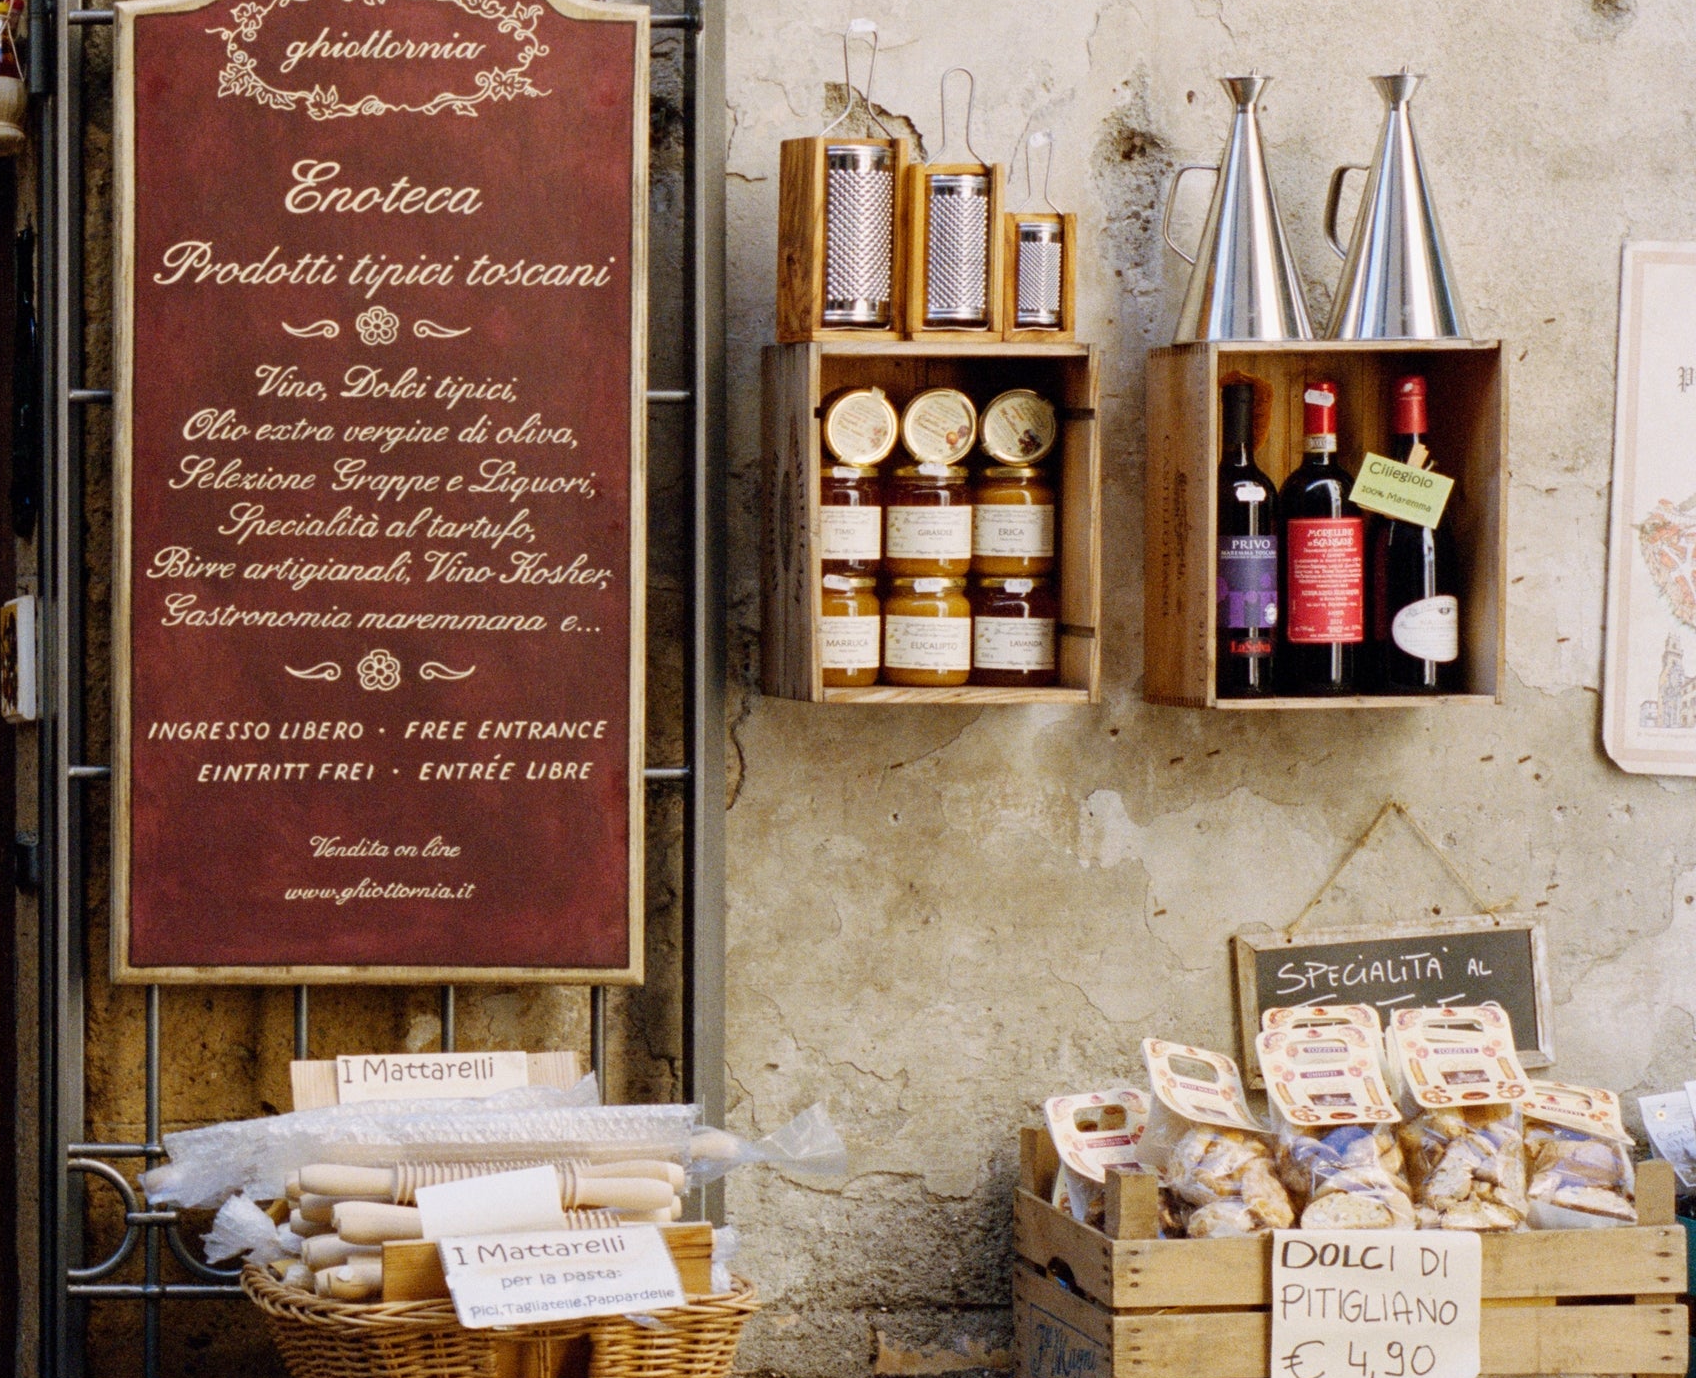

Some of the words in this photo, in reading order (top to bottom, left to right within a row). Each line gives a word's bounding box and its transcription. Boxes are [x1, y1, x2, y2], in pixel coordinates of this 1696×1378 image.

[280, 28, 486, 73] ghiottornia
[285, 160, 482, 215] Enoteca
[154, 242, 343, 288] Prodotti
[349, 255, 460, 299] tipici
[466, 256, 616, 288] toscani
[255, 365, 328, 402] Vino,
[340, 364, 432, 400] Dolci
[434, 376, 518, 410] tipici,
[183, 409, 251, 443] Olio
[255, 422, 336, 443] extra
[344, 422, 448, 452] vergine
[458, 413, 492, 444] di
[496, 414, 579, 449] oliva,
[168, 455, 317, 490] Selezione
[331, 458, 440, 501] Grappe
[446, 476, 463, 492] e
[468, 459, 597, 502] Liquori,
[1370, 461, 1433, 489] Ciliegiolo
[1361, 486, 1385, 500] 100%
[1386, 491, 1432, 514] Maremma
[218, 501, 380, 544] Specialità
[385, 509, 419, 539] al
[426, 509, 537, 549] tartufo,
[834, 528, 855, 536] TIMO
[918, 529, 953, 537] GIRASOLE
[998, 527, 1024, 536] ERICA
[1308, 528, 1354, 537] MORELLINO
[1232, 539, 1271, 549] PRIVO
[146, 546, 238, 579] Birre
[243, 551, 413, 591] artigianali,
[423, 550, 494, 583] Vino
[499, 550, 613, 591] Kosher,
[161, 593, 351, 629] Gastronomia
[358, 612, 548, 632] maremmana
[826, 639, 869, 647] MARRUCA
[910, 642, 958, 651] EUCALIPTO
[1010, 640, 1043, 648] LAVANDA
[148, 721, 270, 741] INGRESSO
[279, 721, 364, 740] LIBERO
[405, 721, 466, 740] FREE
[478, 720, 608, 740] ENTRANCE
[198, 764, 310, 782] EINTRITT
[318, 764, 374, 780] FREI
[419, 754, 516, 781] ENTRÉE
[526, 761, 593, 781] LIBRE
[309, 836, 389, 858] Vendita
[393, 843, 418, 858] on
[421, 836, 461, 858] line
[285, 877, 476, 905] www.ghiottornia.it
[1466, 956, 1493, 978] AL
[342, 1058, 354, 1084] I
[363, 1057, 494, 1083] Mattarelli
[452, 1245, 468, 1266] I
[477, 1234, 626, 1264] Mattarelli
[1281, 1239, 1396, 1272] DOLCI
[1420, 1247, 1448, 1278] DI
[501, 1273, 532, 1290] per
[540, 1271, 557, 1286] la
[563, 1267, 623, 1284] pasta:
[1281, 1283, 1459, 1327] PITIGLIANO
